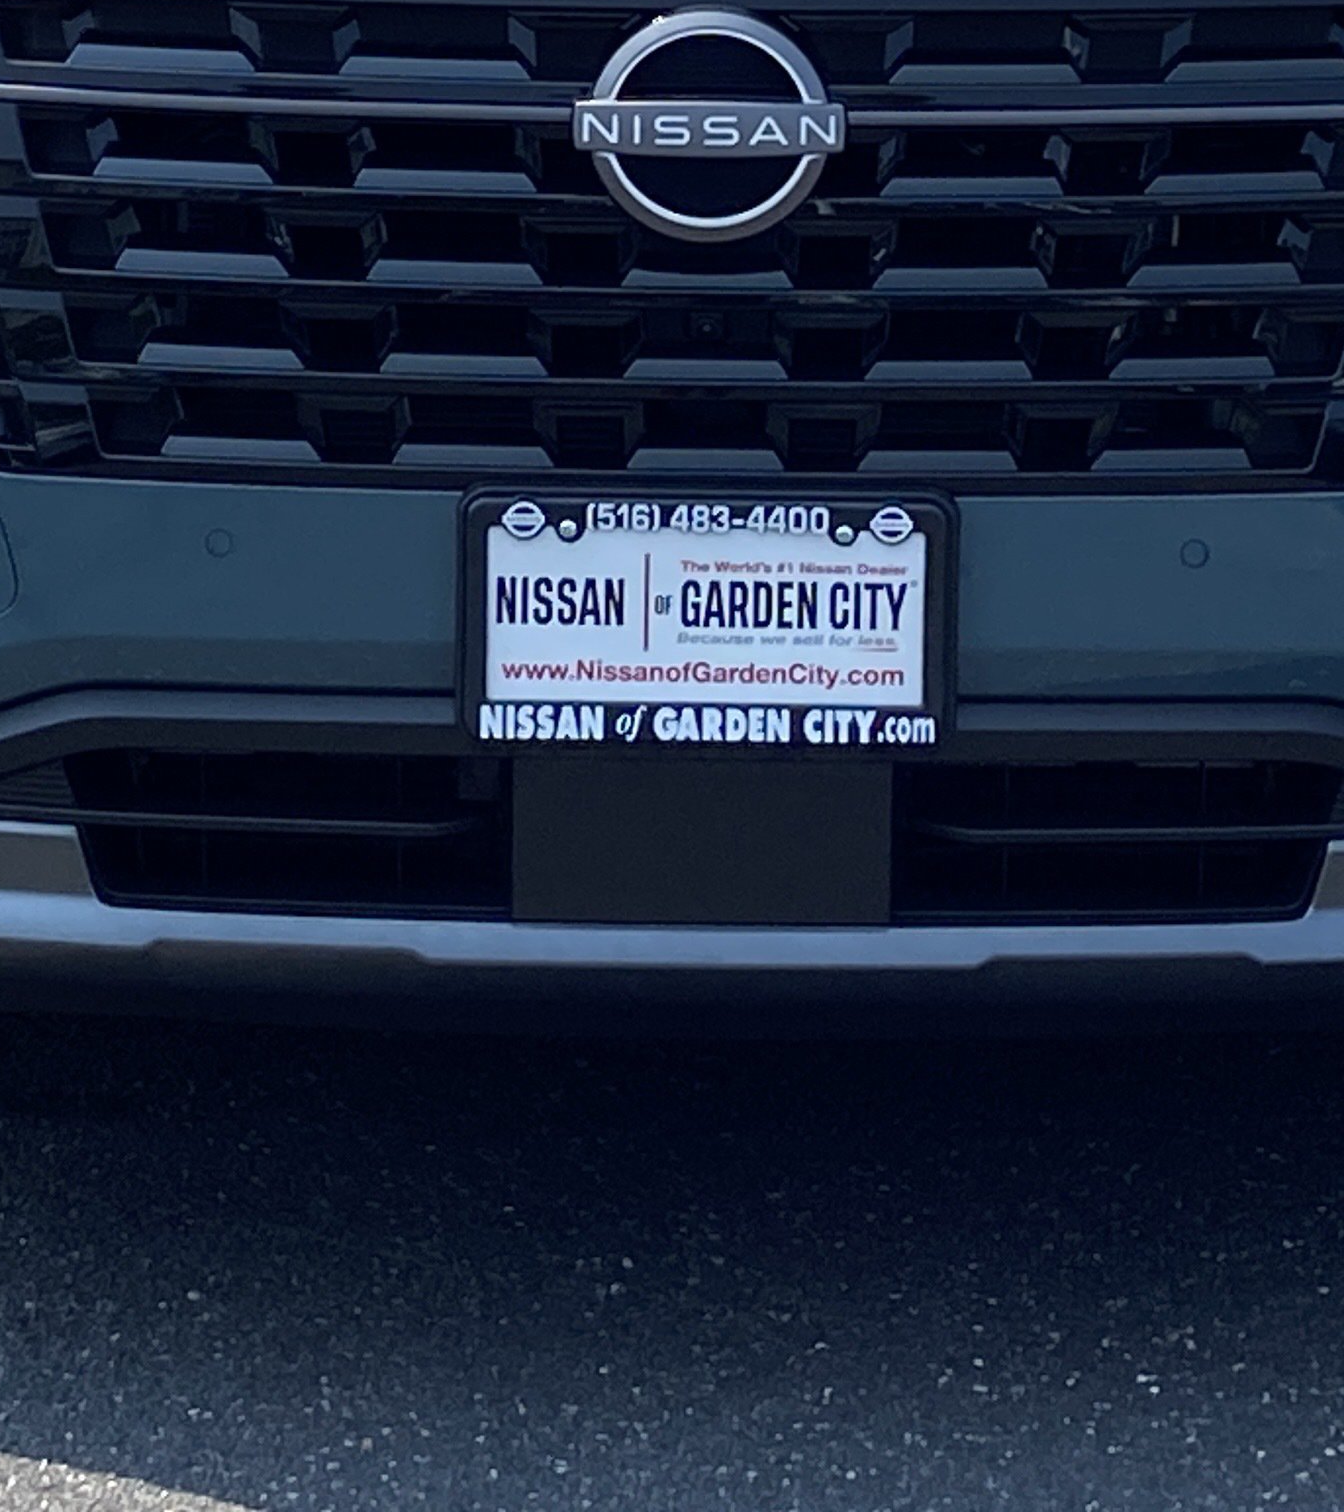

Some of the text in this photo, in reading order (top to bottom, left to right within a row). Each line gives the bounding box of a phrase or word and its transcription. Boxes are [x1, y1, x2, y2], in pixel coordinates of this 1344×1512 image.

[580, 112, 838, 146] NISSAN
[585, 502, 830, 535] (516) 483-4400
[680, 560, 710, 573] The
[799, 563, 853, 576] Nissan
[495, 575, 908, 631] NISSAN OF GARDEN CITY
[501, 659, 905, 690] www.NissanofGardenCity.com
[479, 704, 936, 745] NISSAN of GARDEN CITY.com
